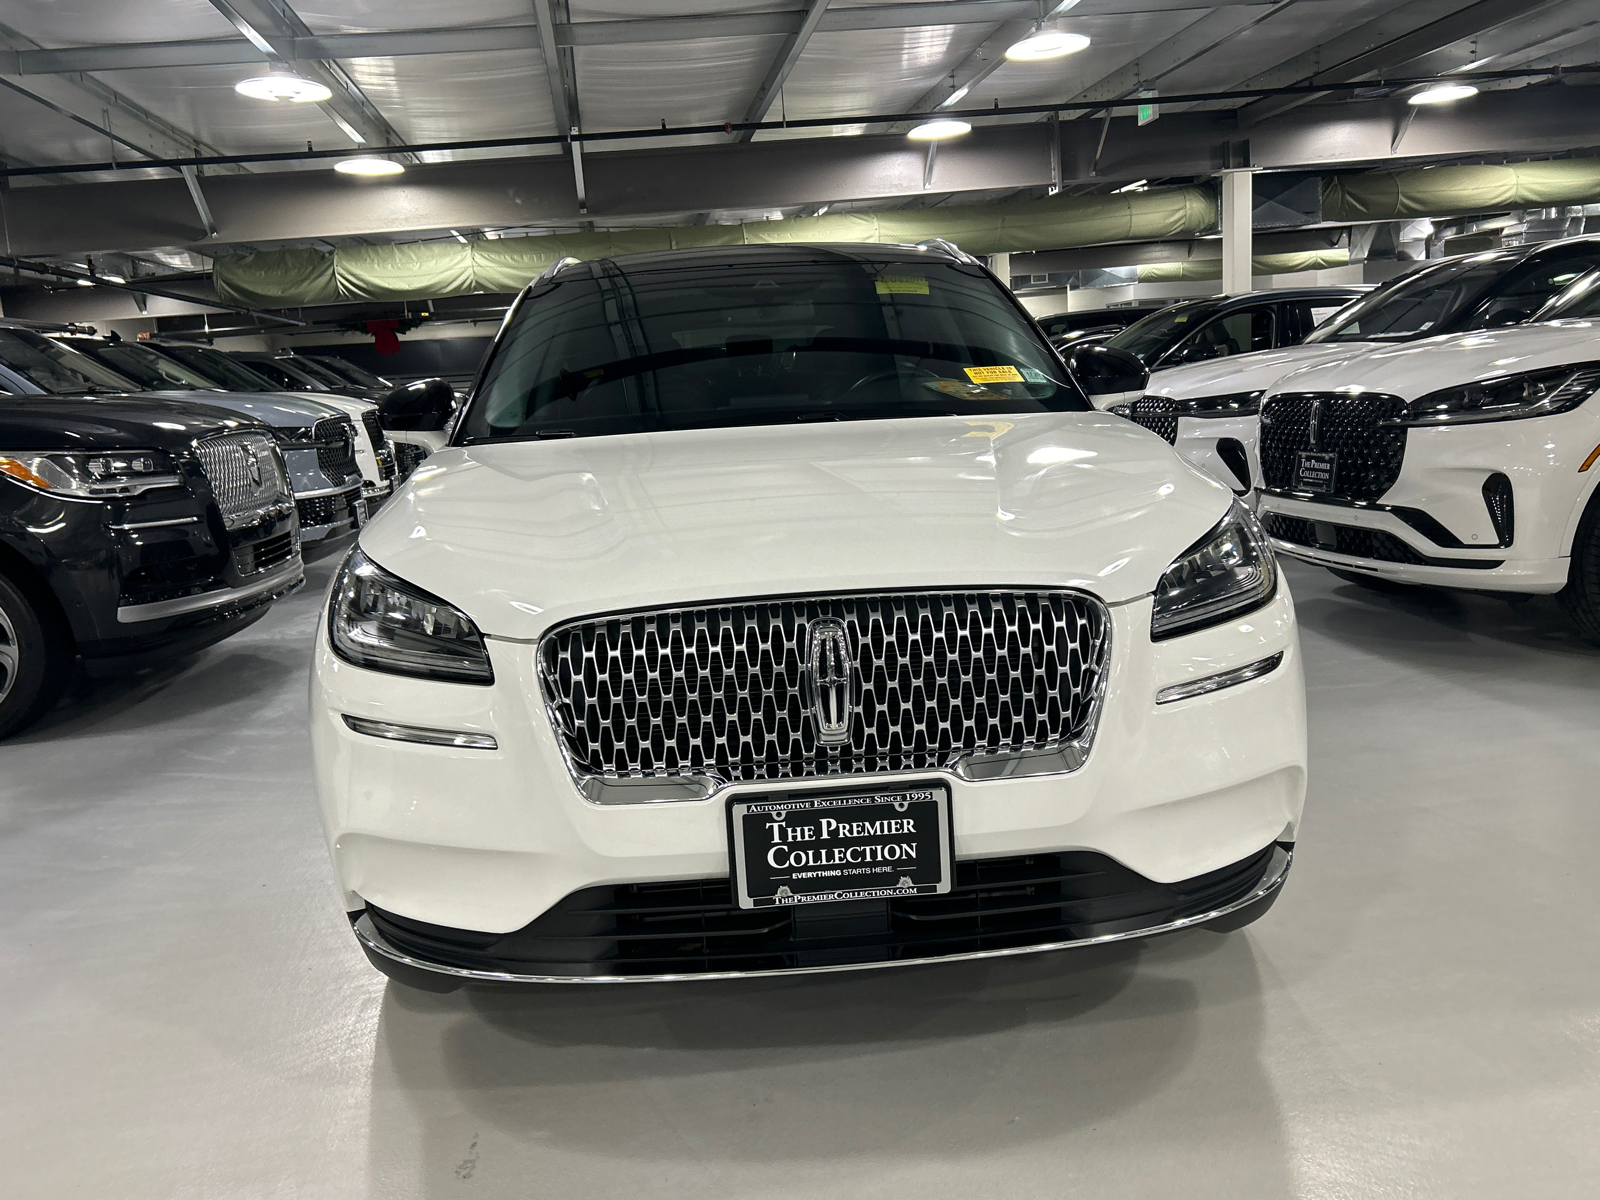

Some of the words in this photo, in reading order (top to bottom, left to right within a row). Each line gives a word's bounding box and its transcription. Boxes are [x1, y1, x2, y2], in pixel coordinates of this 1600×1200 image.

[748, 801, 812, 813] AUTOMOTIVE
[813, 797, 872, 808] EXCELLENCE
[874, 795, 903, 803] SINCE
[905, 792, 932, 801] 1995
[765, 821, 816, 844] THE
[818, 818, 917, 840] PREMIER
[767, 842, 918, 869] COLLECTION
[792, 869, 842, 880] EVERYTHING
[842, 867, 871, 876] STARTS
